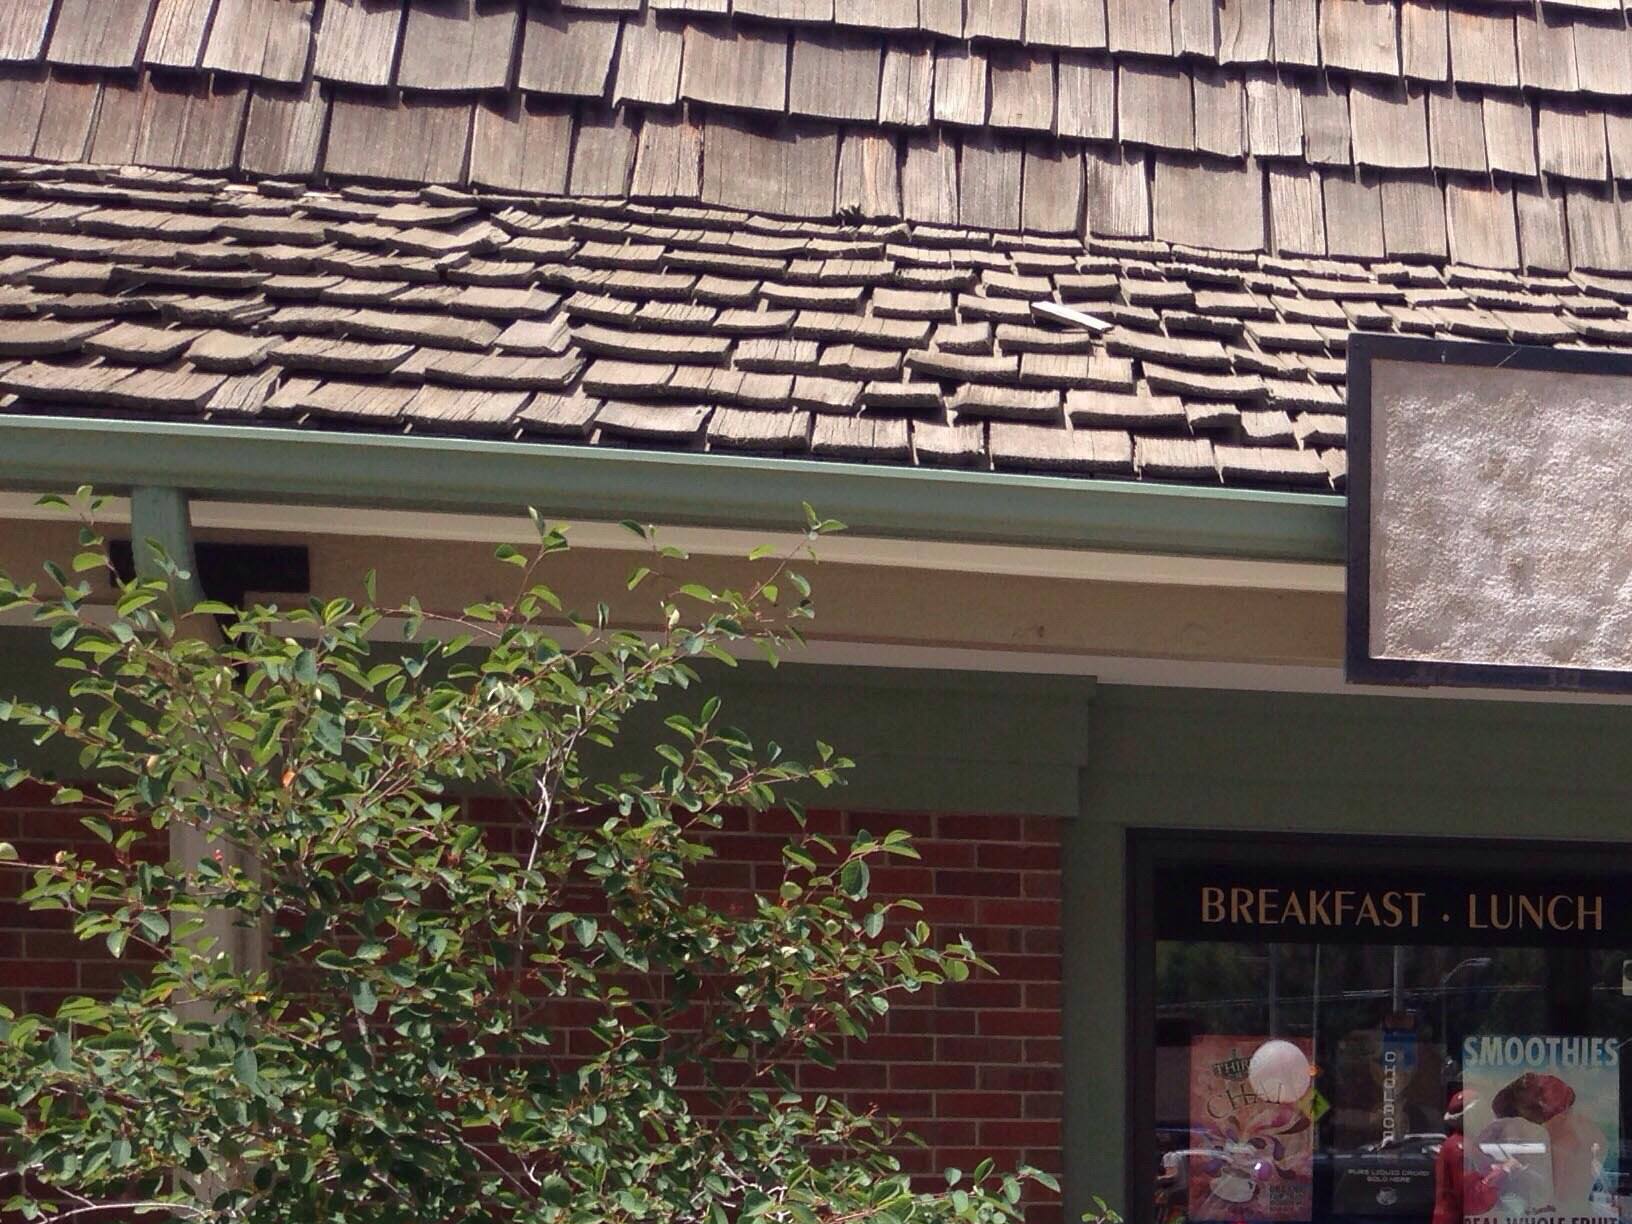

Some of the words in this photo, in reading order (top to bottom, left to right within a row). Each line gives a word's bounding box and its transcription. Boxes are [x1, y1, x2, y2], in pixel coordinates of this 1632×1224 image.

[1201, 886, 1426, 929] BREAKFAST
[1468, 893, 1603, 931] LUNCH
[1463, 1036, 1620, 1067] SMOOTHIES
